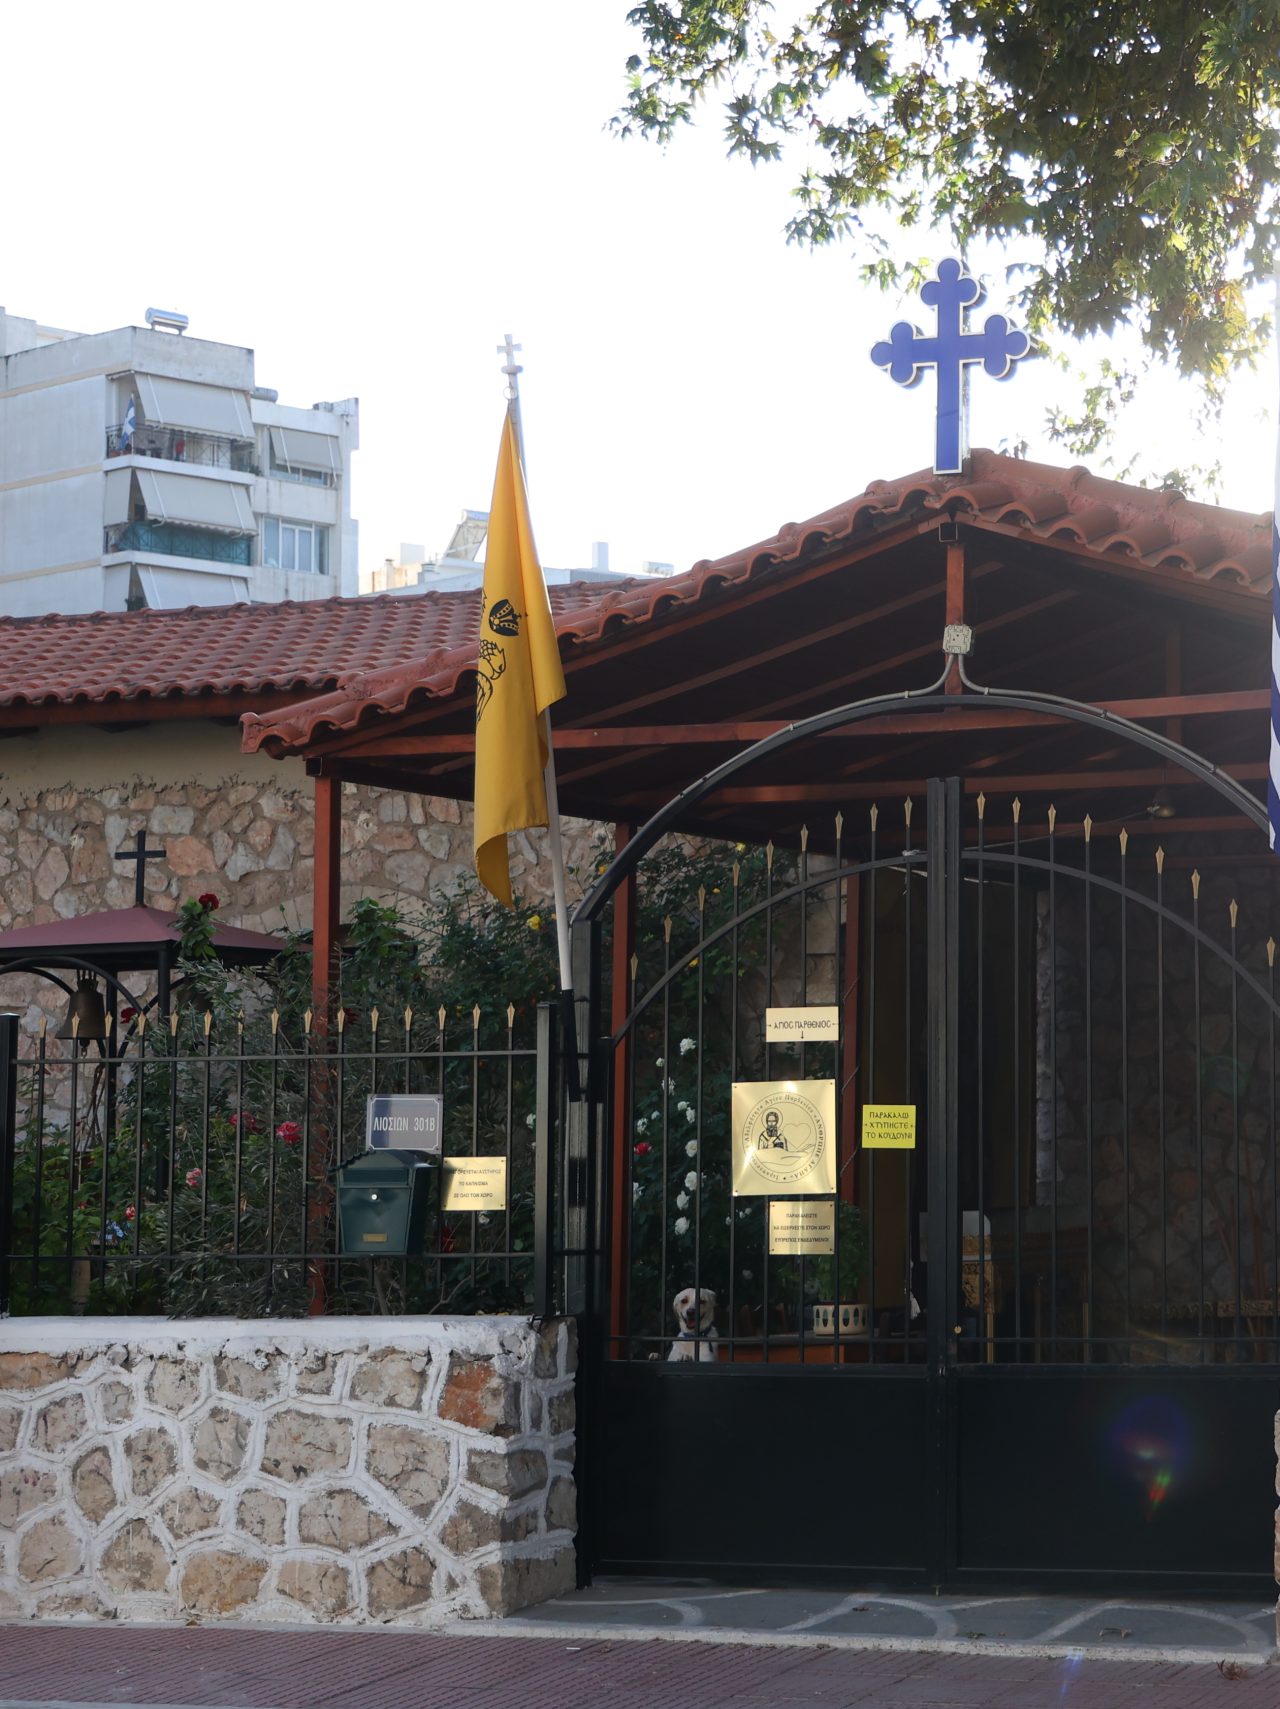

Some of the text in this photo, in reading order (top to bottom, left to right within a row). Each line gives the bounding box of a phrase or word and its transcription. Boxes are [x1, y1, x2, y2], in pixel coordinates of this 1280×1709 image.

[869, 1111, 909, 1119] ΠΑΡΑΚΑΛΩ
[373, 1116, 409, 1131] ΛΙΟΣΙΩΝ
[878, 1132, 913, 1140] ΚΟΥΔΟΥΝΙ
